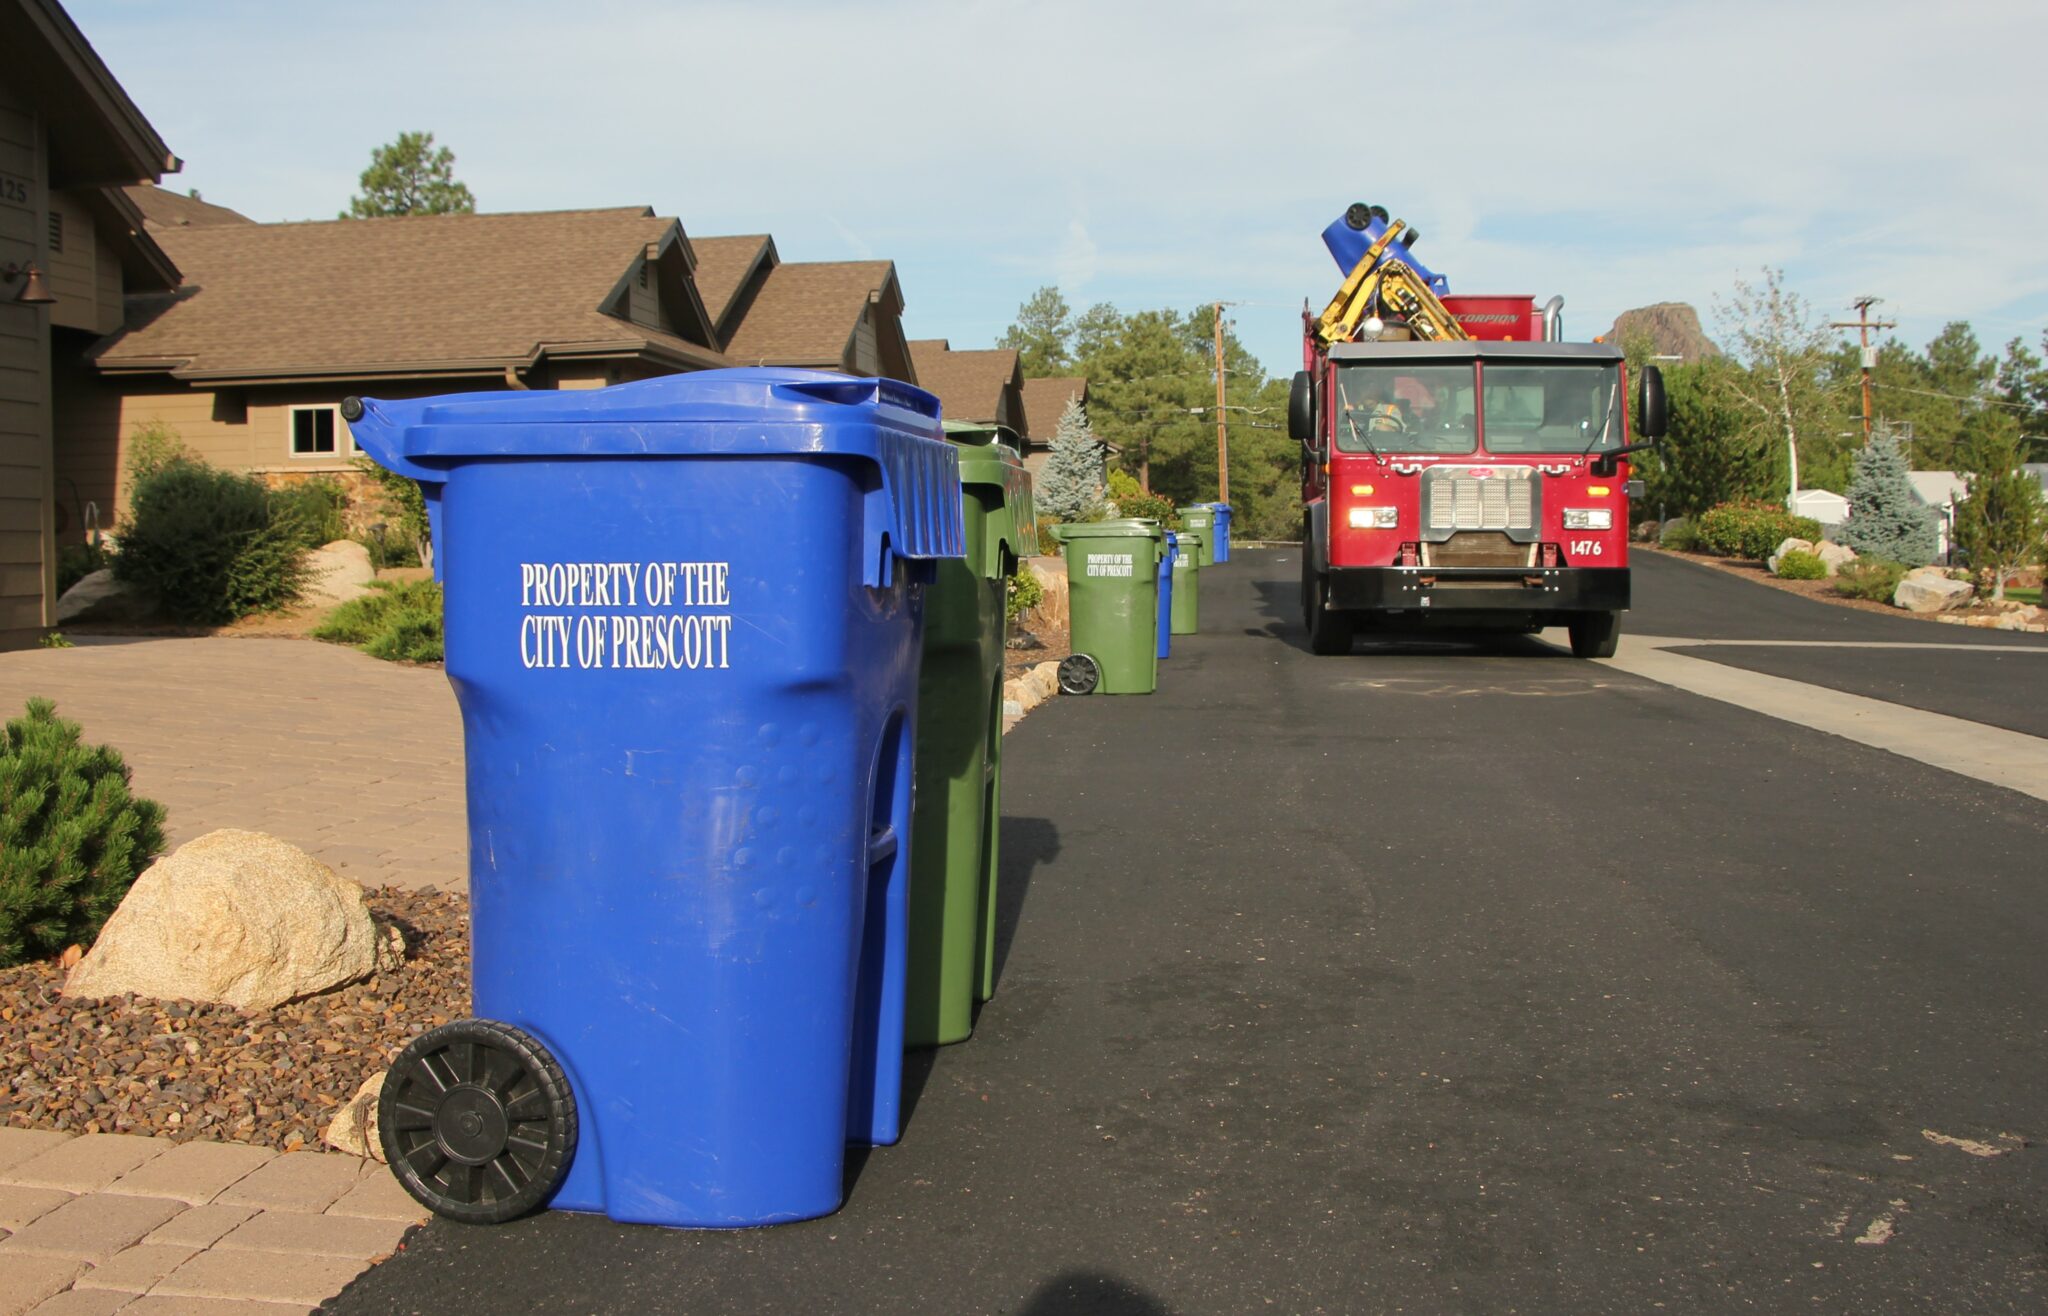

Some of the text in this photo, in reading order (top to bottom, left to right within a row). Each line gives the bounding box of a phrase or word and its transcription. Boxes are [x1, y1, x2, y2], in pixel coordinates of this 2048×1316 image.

[1570, 540, 1602, 555] 1476
[1087, 553, 1114, 564] PROPERTY
[1114, 553, 1121, 564] OF
[1087, 565, 1133, 576] CITY OF PRESCOTT
[521, 562, 730, 606] PROPERTY OF THE
[521, 615, 732, 669] CITY OF PRESCOTT
